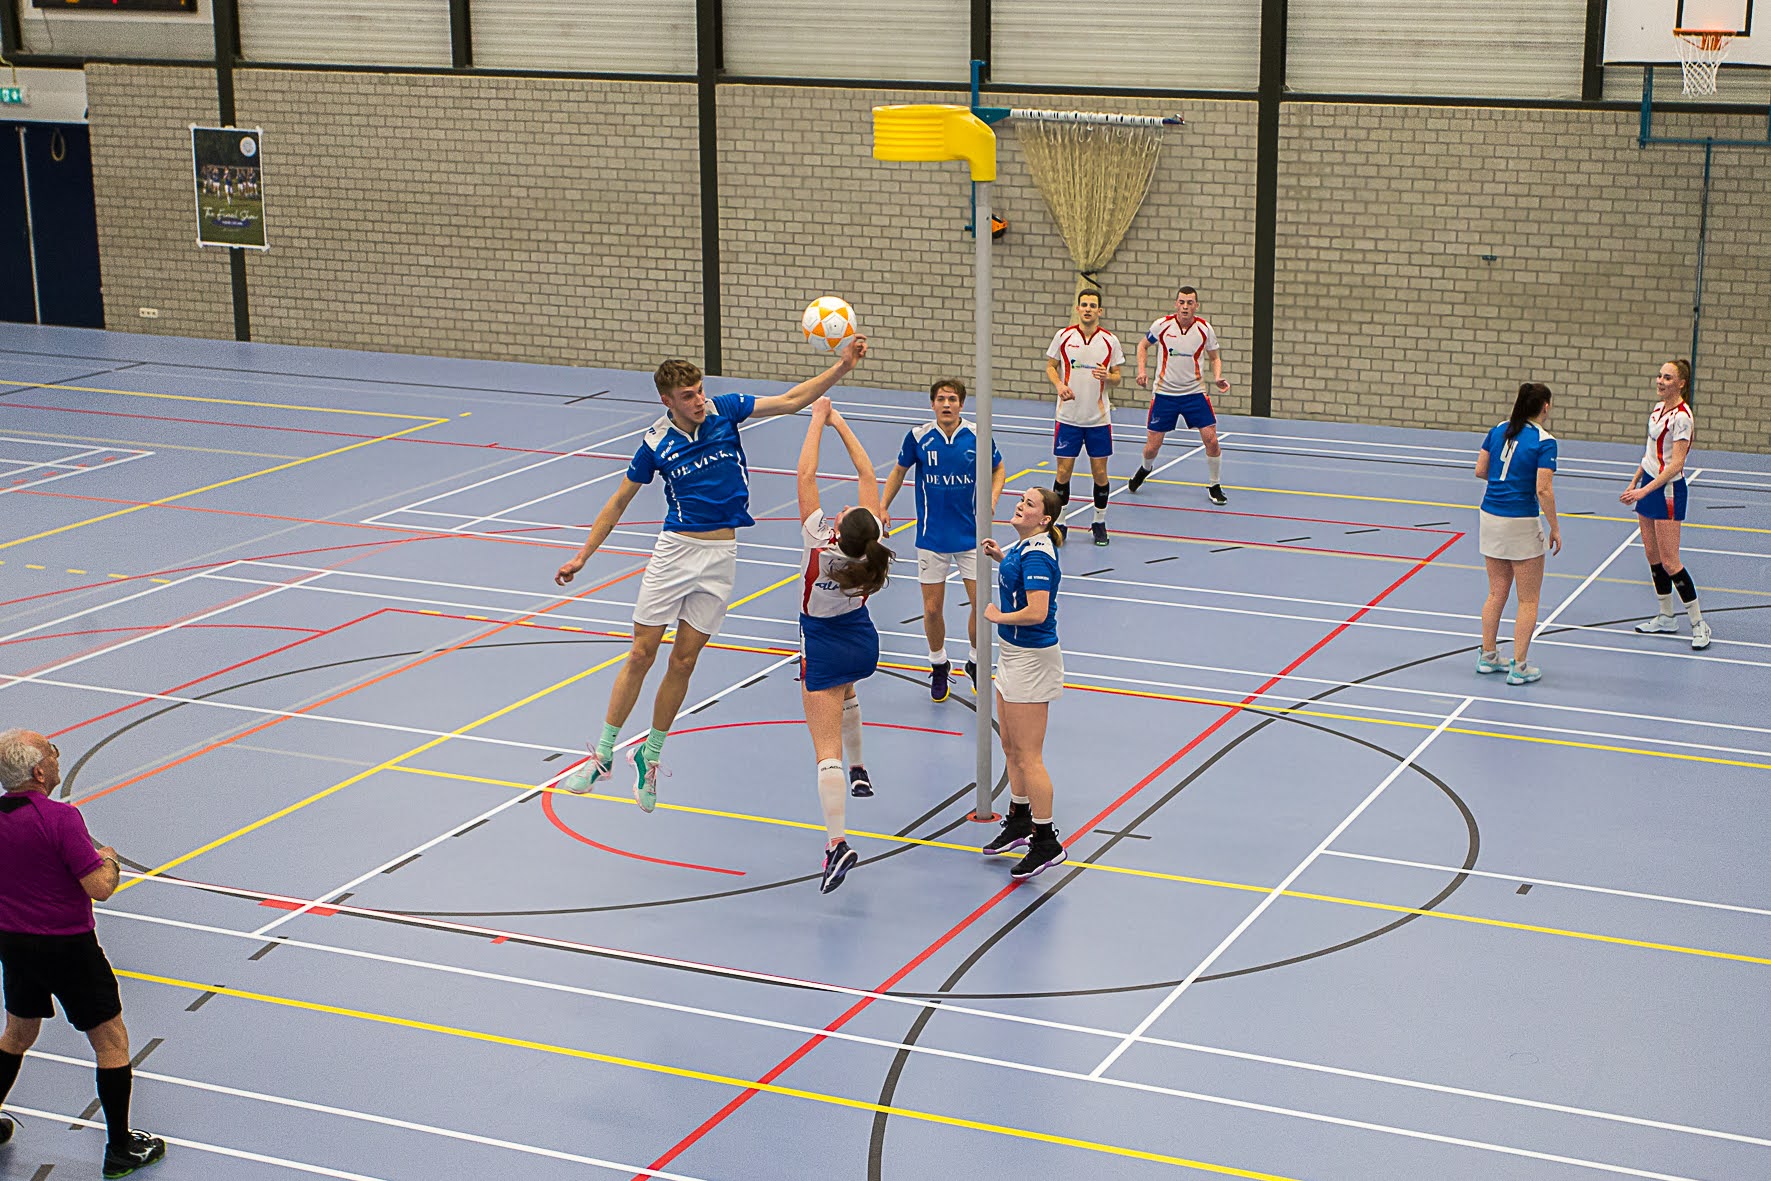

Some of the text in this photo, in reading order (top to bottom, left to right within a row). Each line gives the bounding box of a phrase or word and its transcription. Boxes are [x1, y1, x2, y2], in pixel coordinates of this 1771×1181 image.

[927, 450, 938, 467] 14
[1499, 439, 1519, 482] 4
[926, 473, 940, 485] DE
